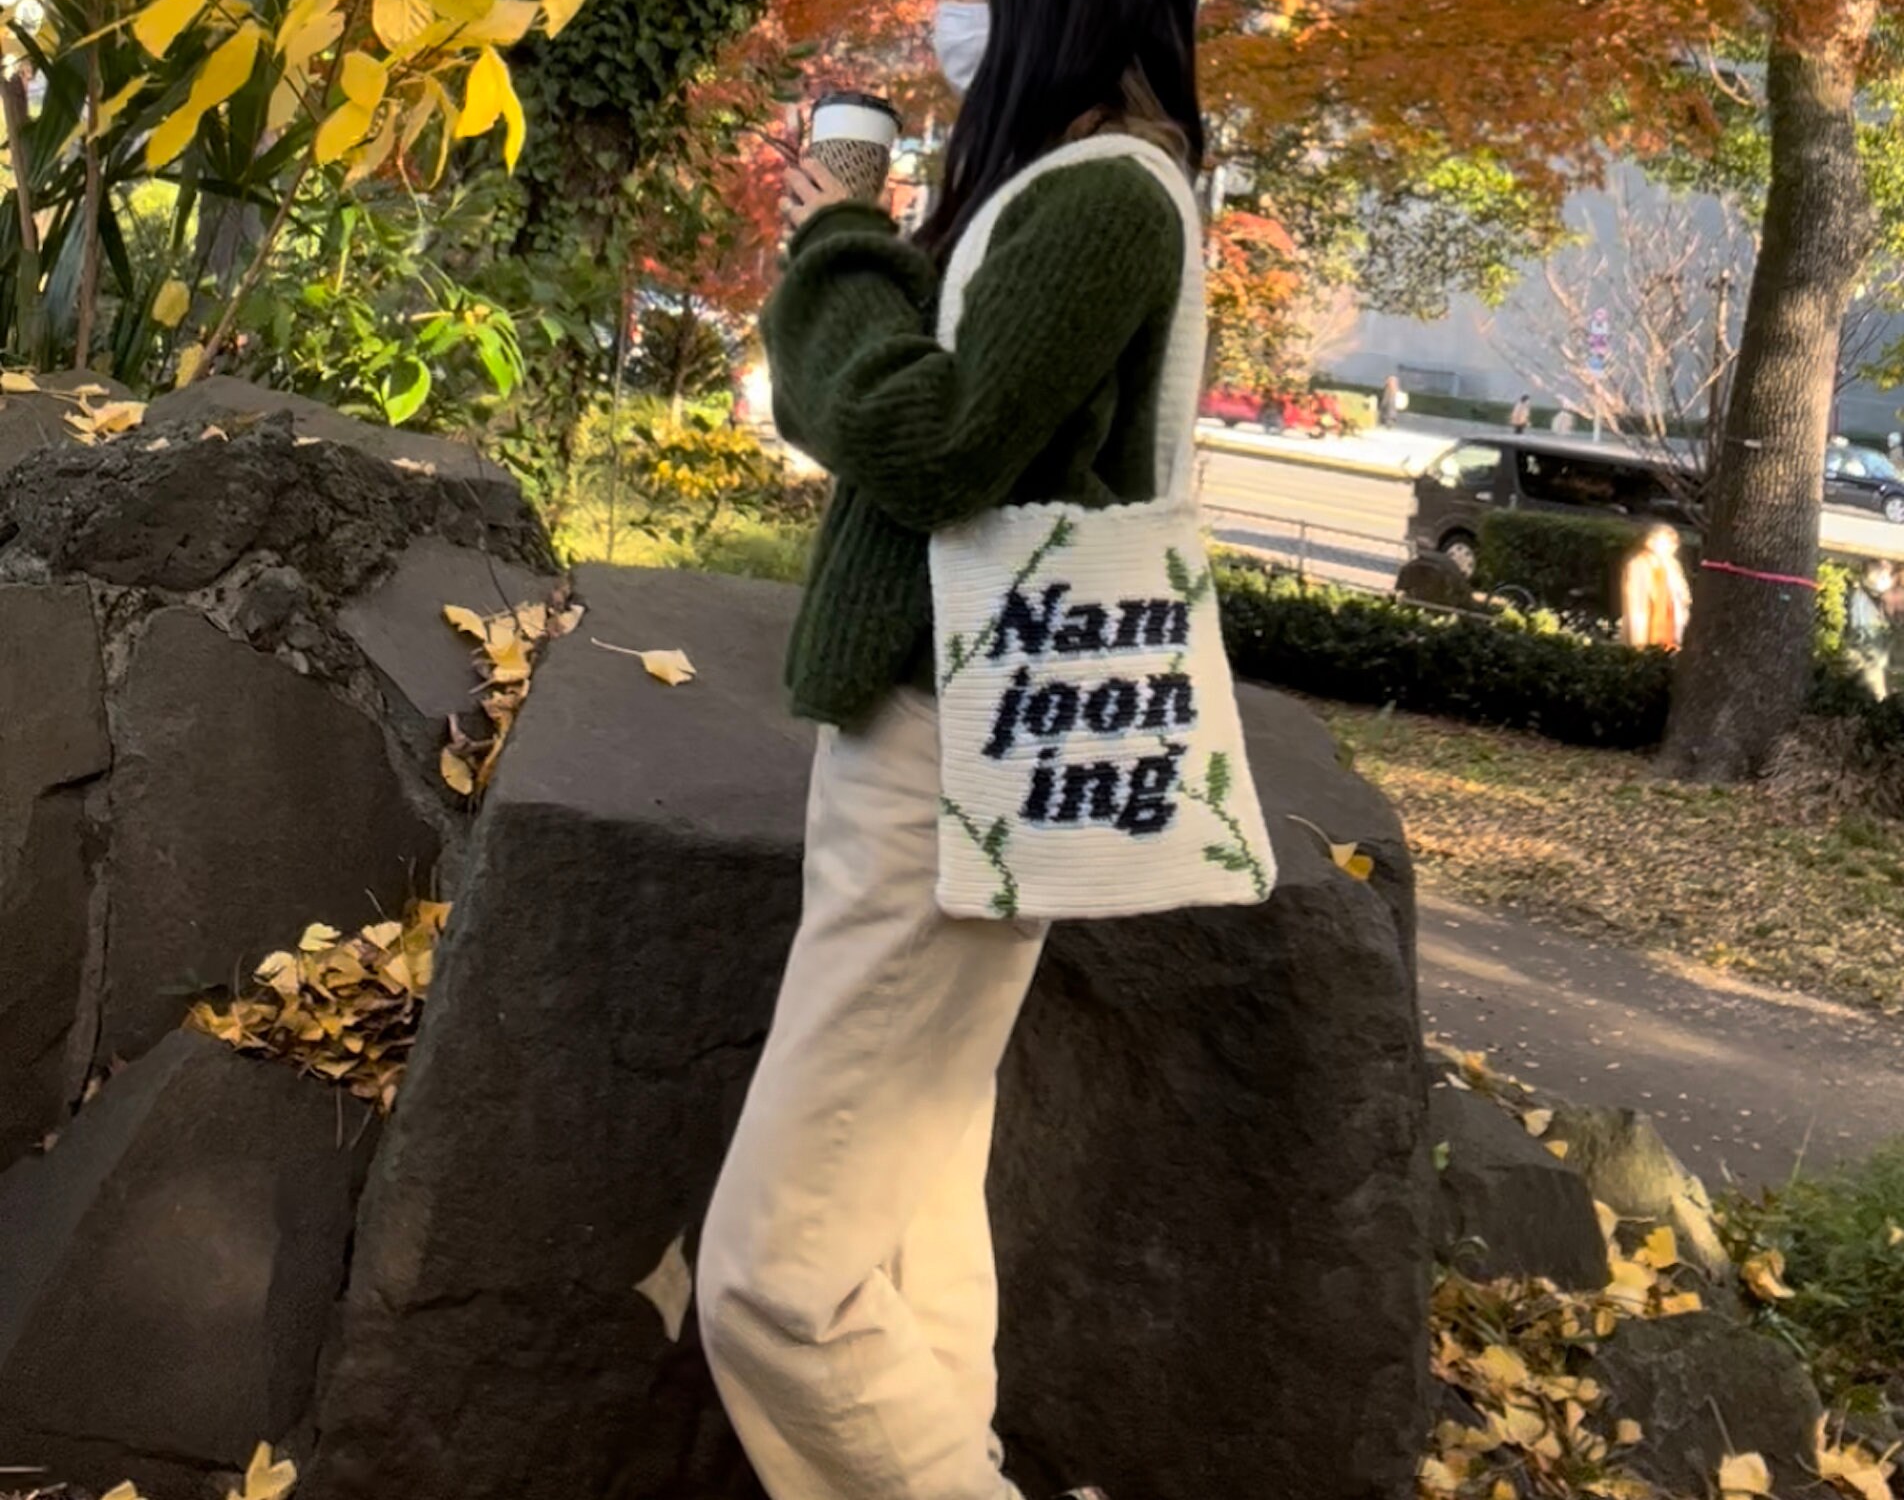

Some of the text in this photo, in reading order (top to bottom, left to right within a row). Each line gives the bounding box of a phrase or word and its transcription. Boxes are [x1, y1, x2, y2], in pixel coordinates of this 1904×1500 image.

[988, 582, 1190, 659] Nam
[982, 665, 1198, 760] joon
[1019, 743, 1188, 836] ing
